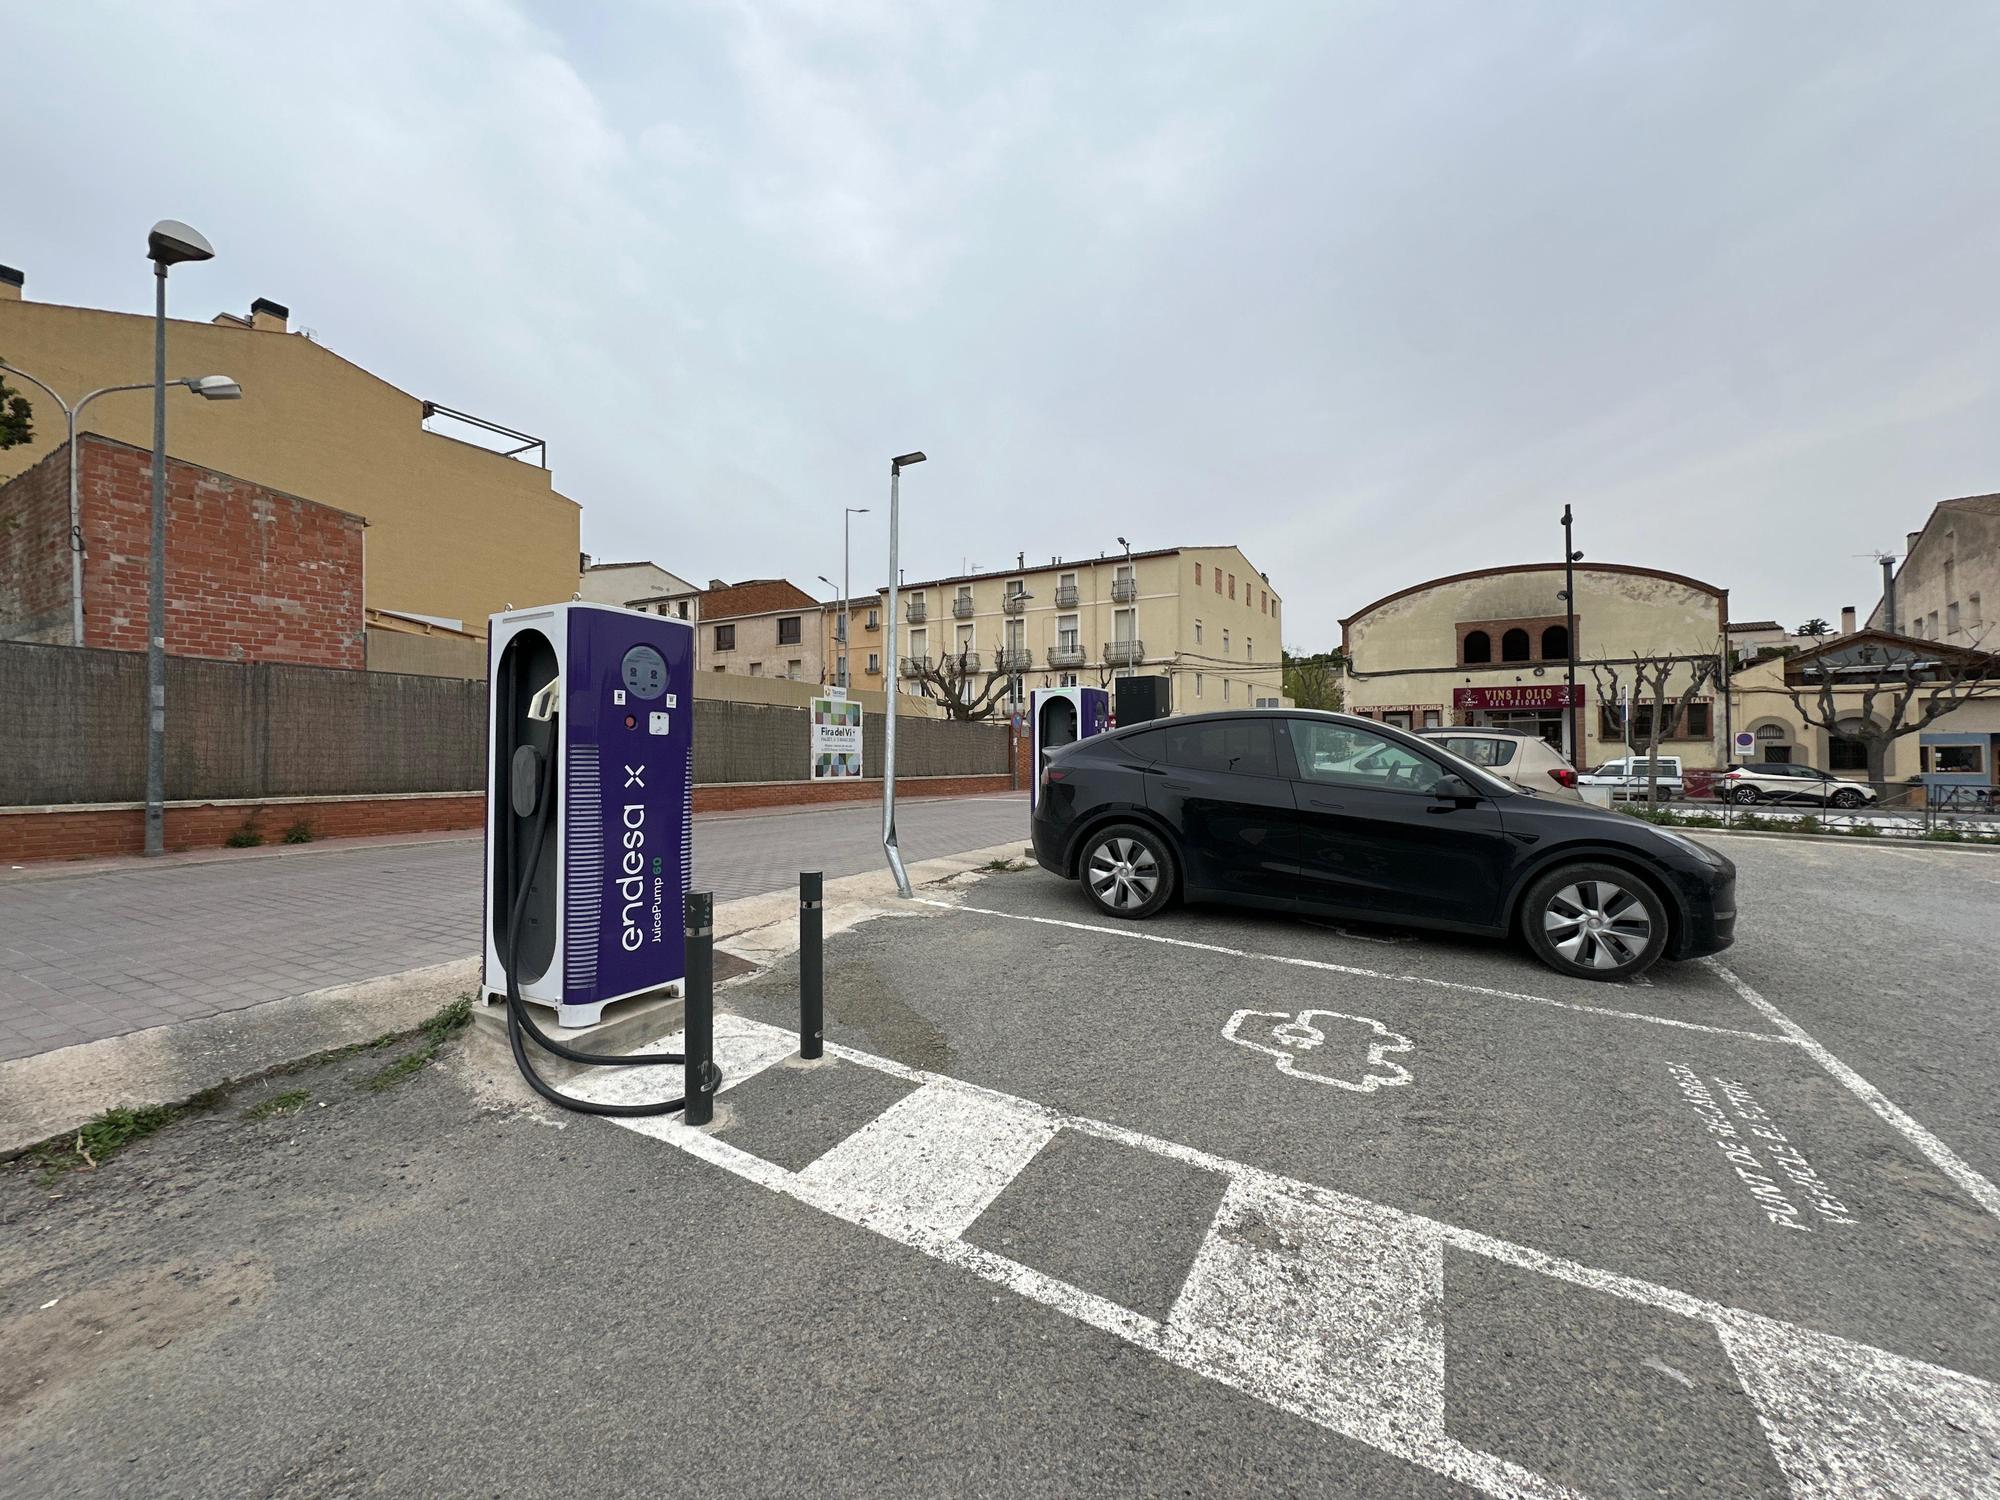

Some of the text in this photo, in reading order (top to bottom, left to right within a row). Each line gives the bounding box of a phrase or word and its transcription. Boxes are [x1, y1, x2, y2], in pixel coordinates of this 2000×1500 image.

[1485, 688, 1552, 700] VINS I OLIS
[1510, 699, 1547, 707] PRIORAT
[821, 727, 834, 736] Fira
[835, 727, 844, 736] del
[616, 804, 645, 951] endesa
[652, 857, 664, 943] JuicePump 60
[1715, 1140, 1764, 1169] DE
[1734, 1166, 1812, 1232] PUNT
